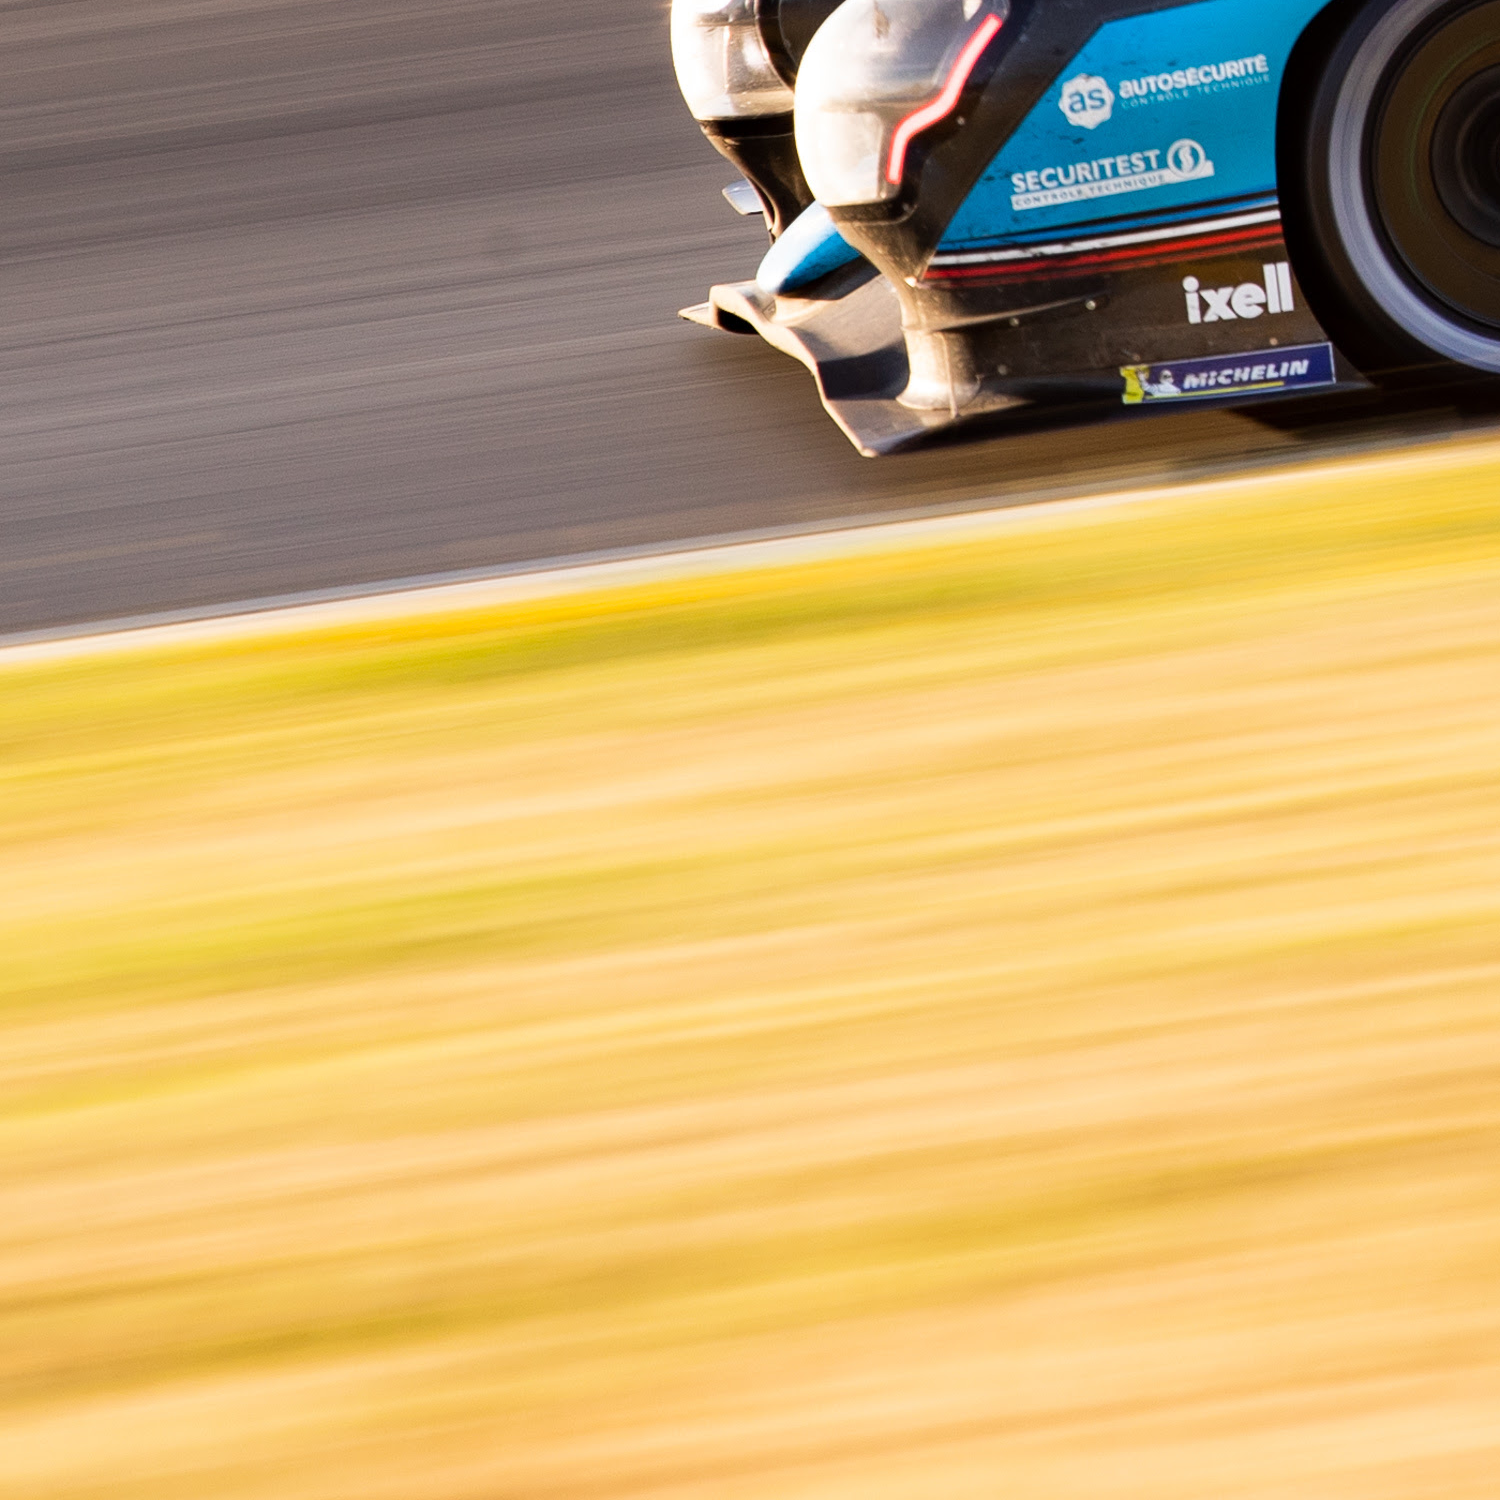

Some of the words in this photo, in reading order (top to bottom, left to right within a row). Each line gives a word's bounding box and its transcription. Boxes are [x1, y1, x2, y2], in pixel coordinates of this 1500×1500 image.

[1198, 74, 1271, 95] TECHNIQUE
[1068, 88, 1106, 114] as
[1010, 149, 1161, 194] SECURITEST
[1182, 261, 1294, 324] ixell
[1182, 359, 1309, 389] MICHELIN
